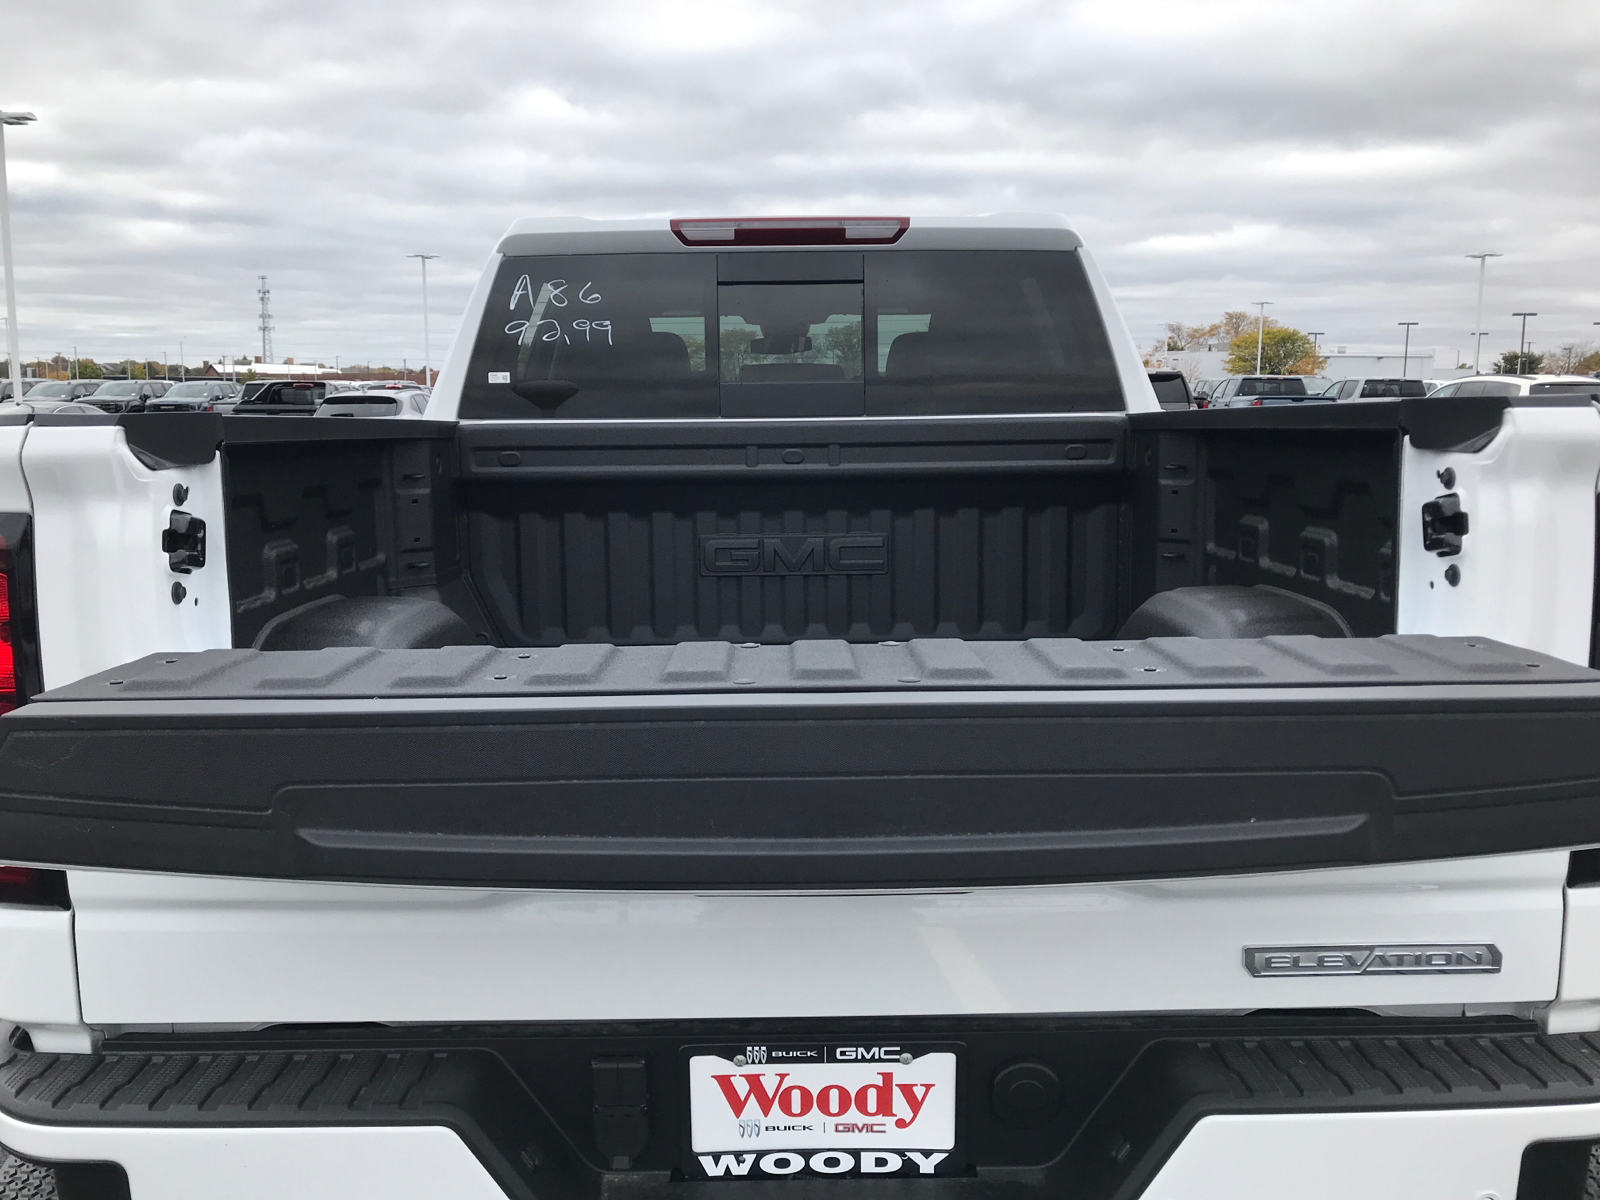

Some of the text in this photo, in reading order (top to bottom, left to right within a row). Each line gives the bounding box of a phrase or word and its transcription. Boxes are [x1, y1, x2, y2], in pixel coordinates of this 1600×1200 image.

[704, 537, 886, 573] GMC
[1264, 951, 1483, 970] ELEVATION
[771, 1047, 901, 1060] BUICK GMC
[711, 1072, 936, 1129] Woody
[765, 1123, 887, 1134] BUICK GMC
[698, 1151, 950, 1177] WOODY
